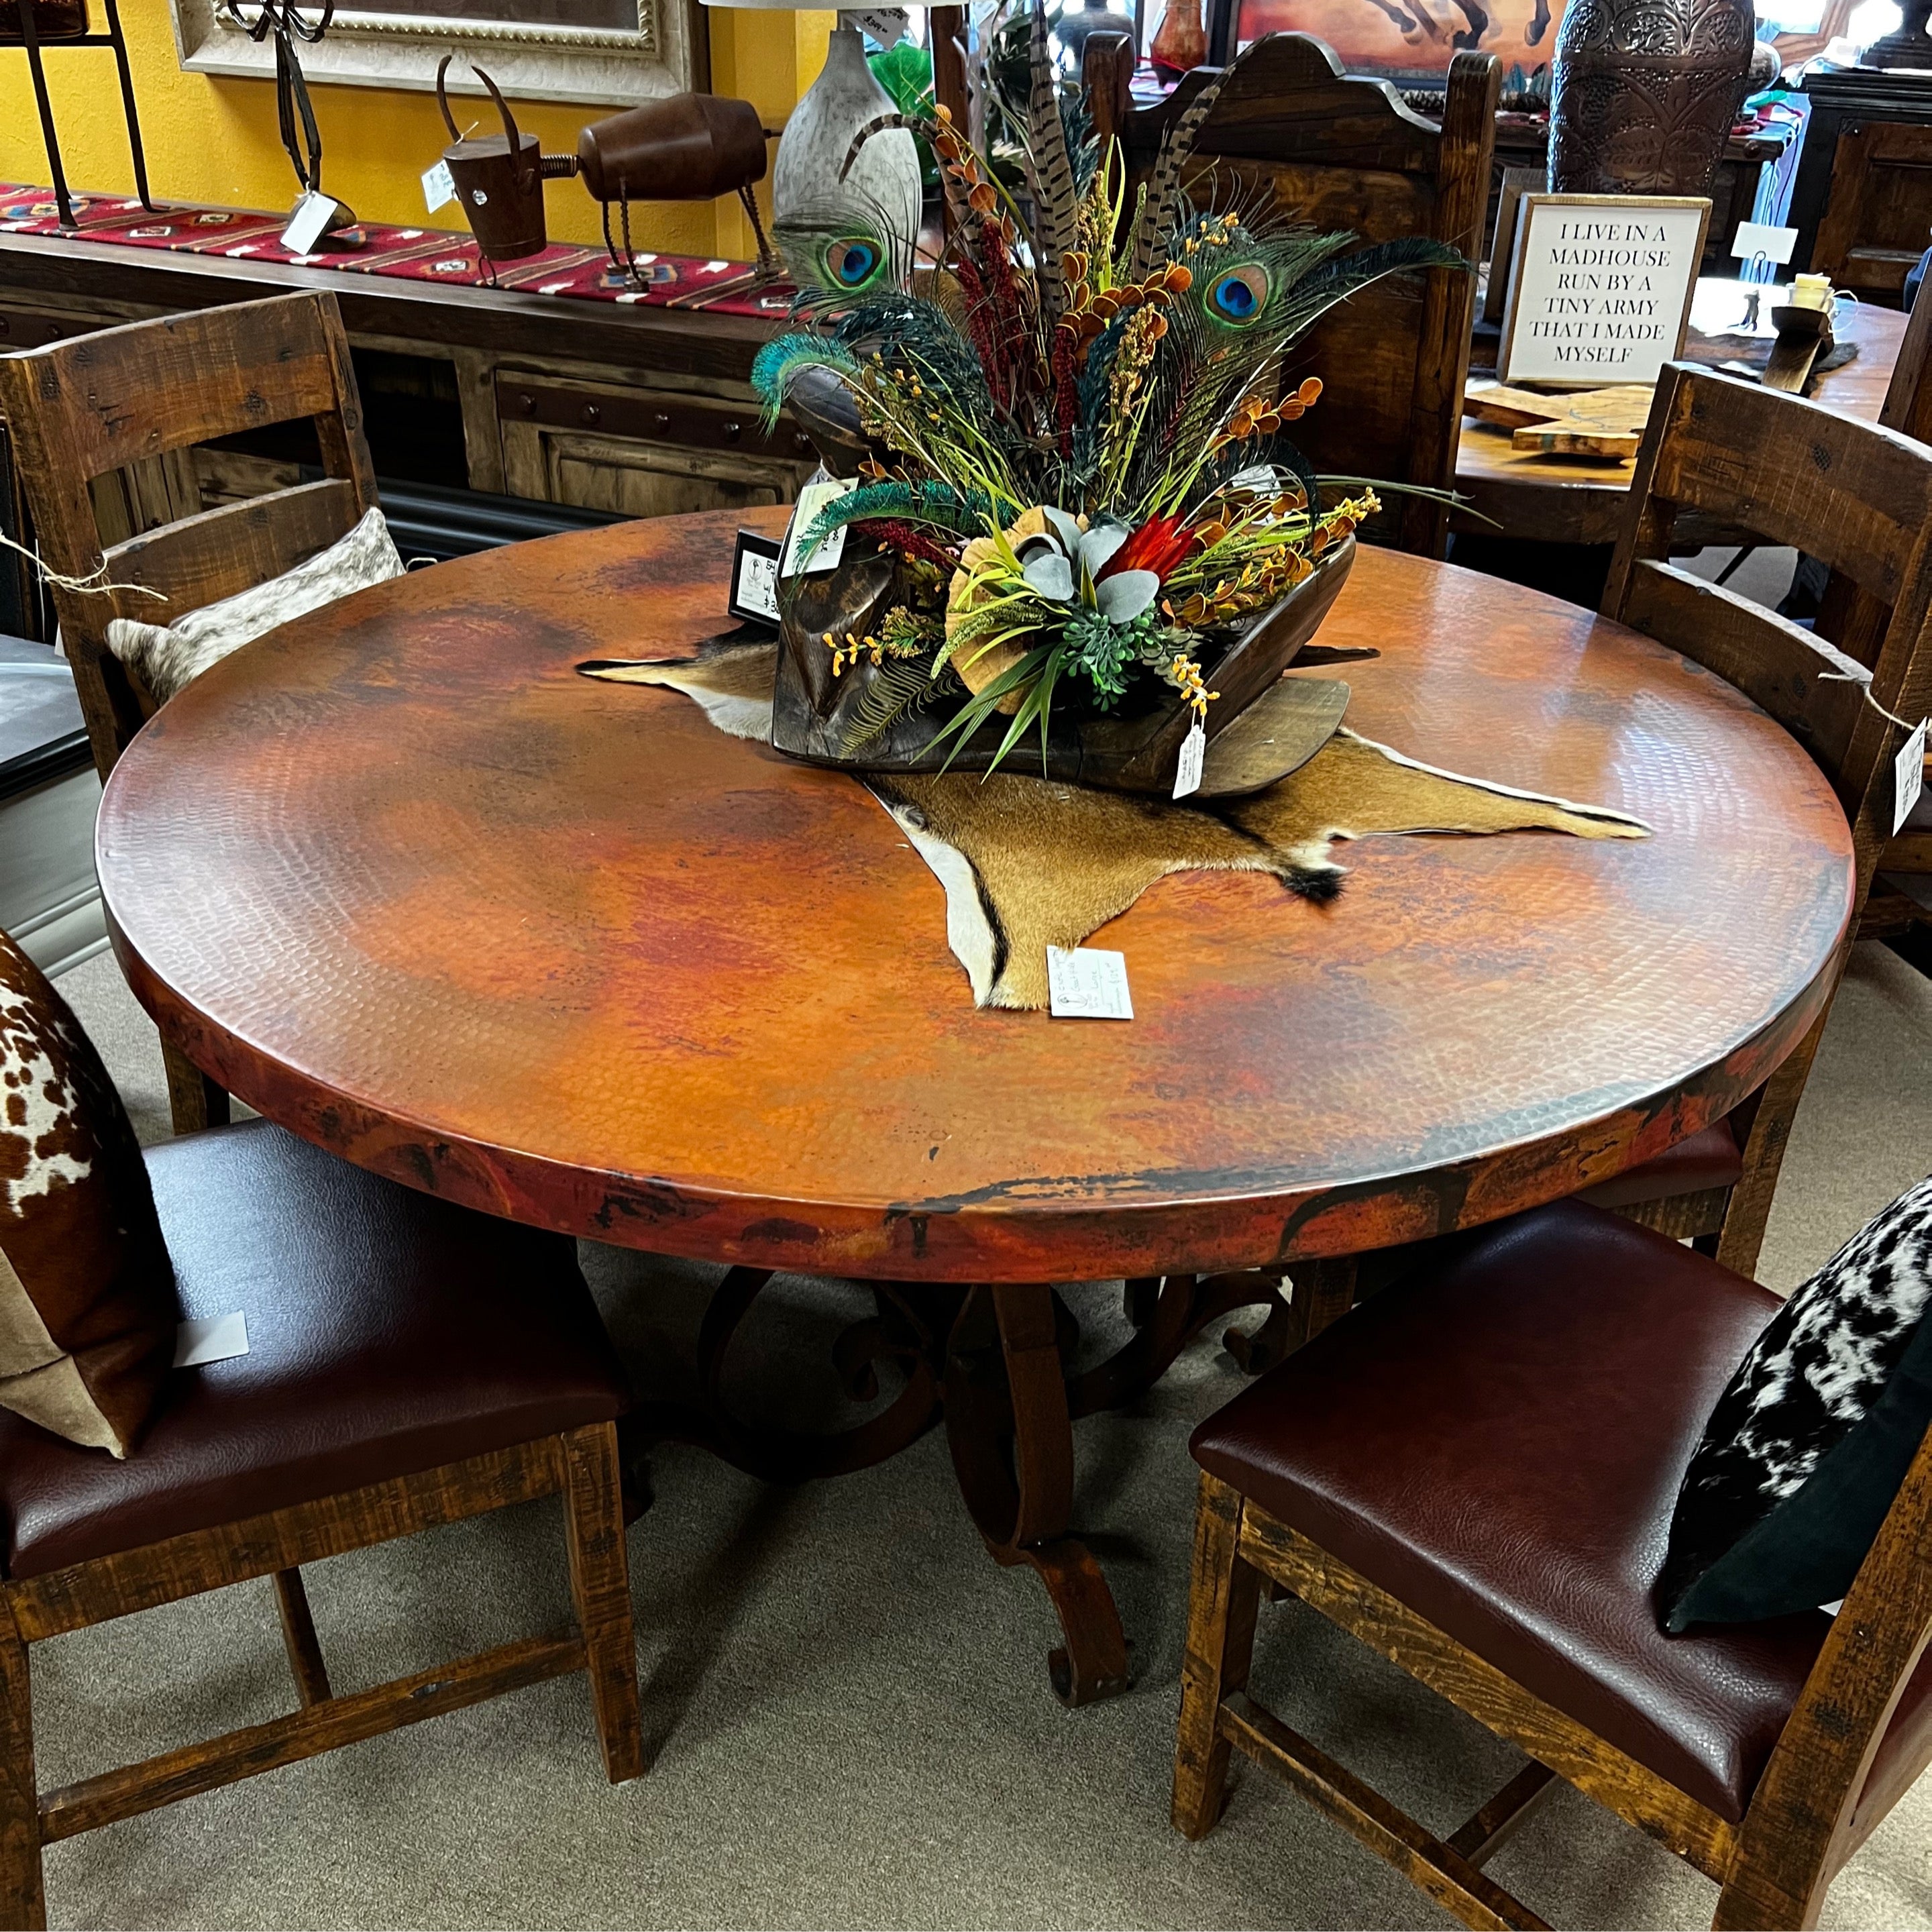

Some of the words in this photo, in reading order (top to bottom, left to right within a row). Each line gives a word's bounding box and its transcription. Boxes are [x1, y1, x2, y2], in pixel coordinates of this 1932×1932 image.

[1560, 223, 1568, 240] I
[1573, 224, 1620, 241] LIVE
[1625, 225, 1649, 241] IN
[1652, 226, 1666, 241] A
[1550, 248, 1671, 267] MADHOUSE
[1558, 274, 1601, 290] RUN
[1607, 275, 1634, 290] BY
[1638, 276, 1651, 291] A
[1544, 297, 1595, 314] TINY
[1598, 299, 1659, 315] ARMY
[1529, 321, 1589, 337] THAT
[1592, 323, 1599, 338] I
[1604, 323, 1665, 340] MADE
[1554, 346, 1633, 363] MYSELF
